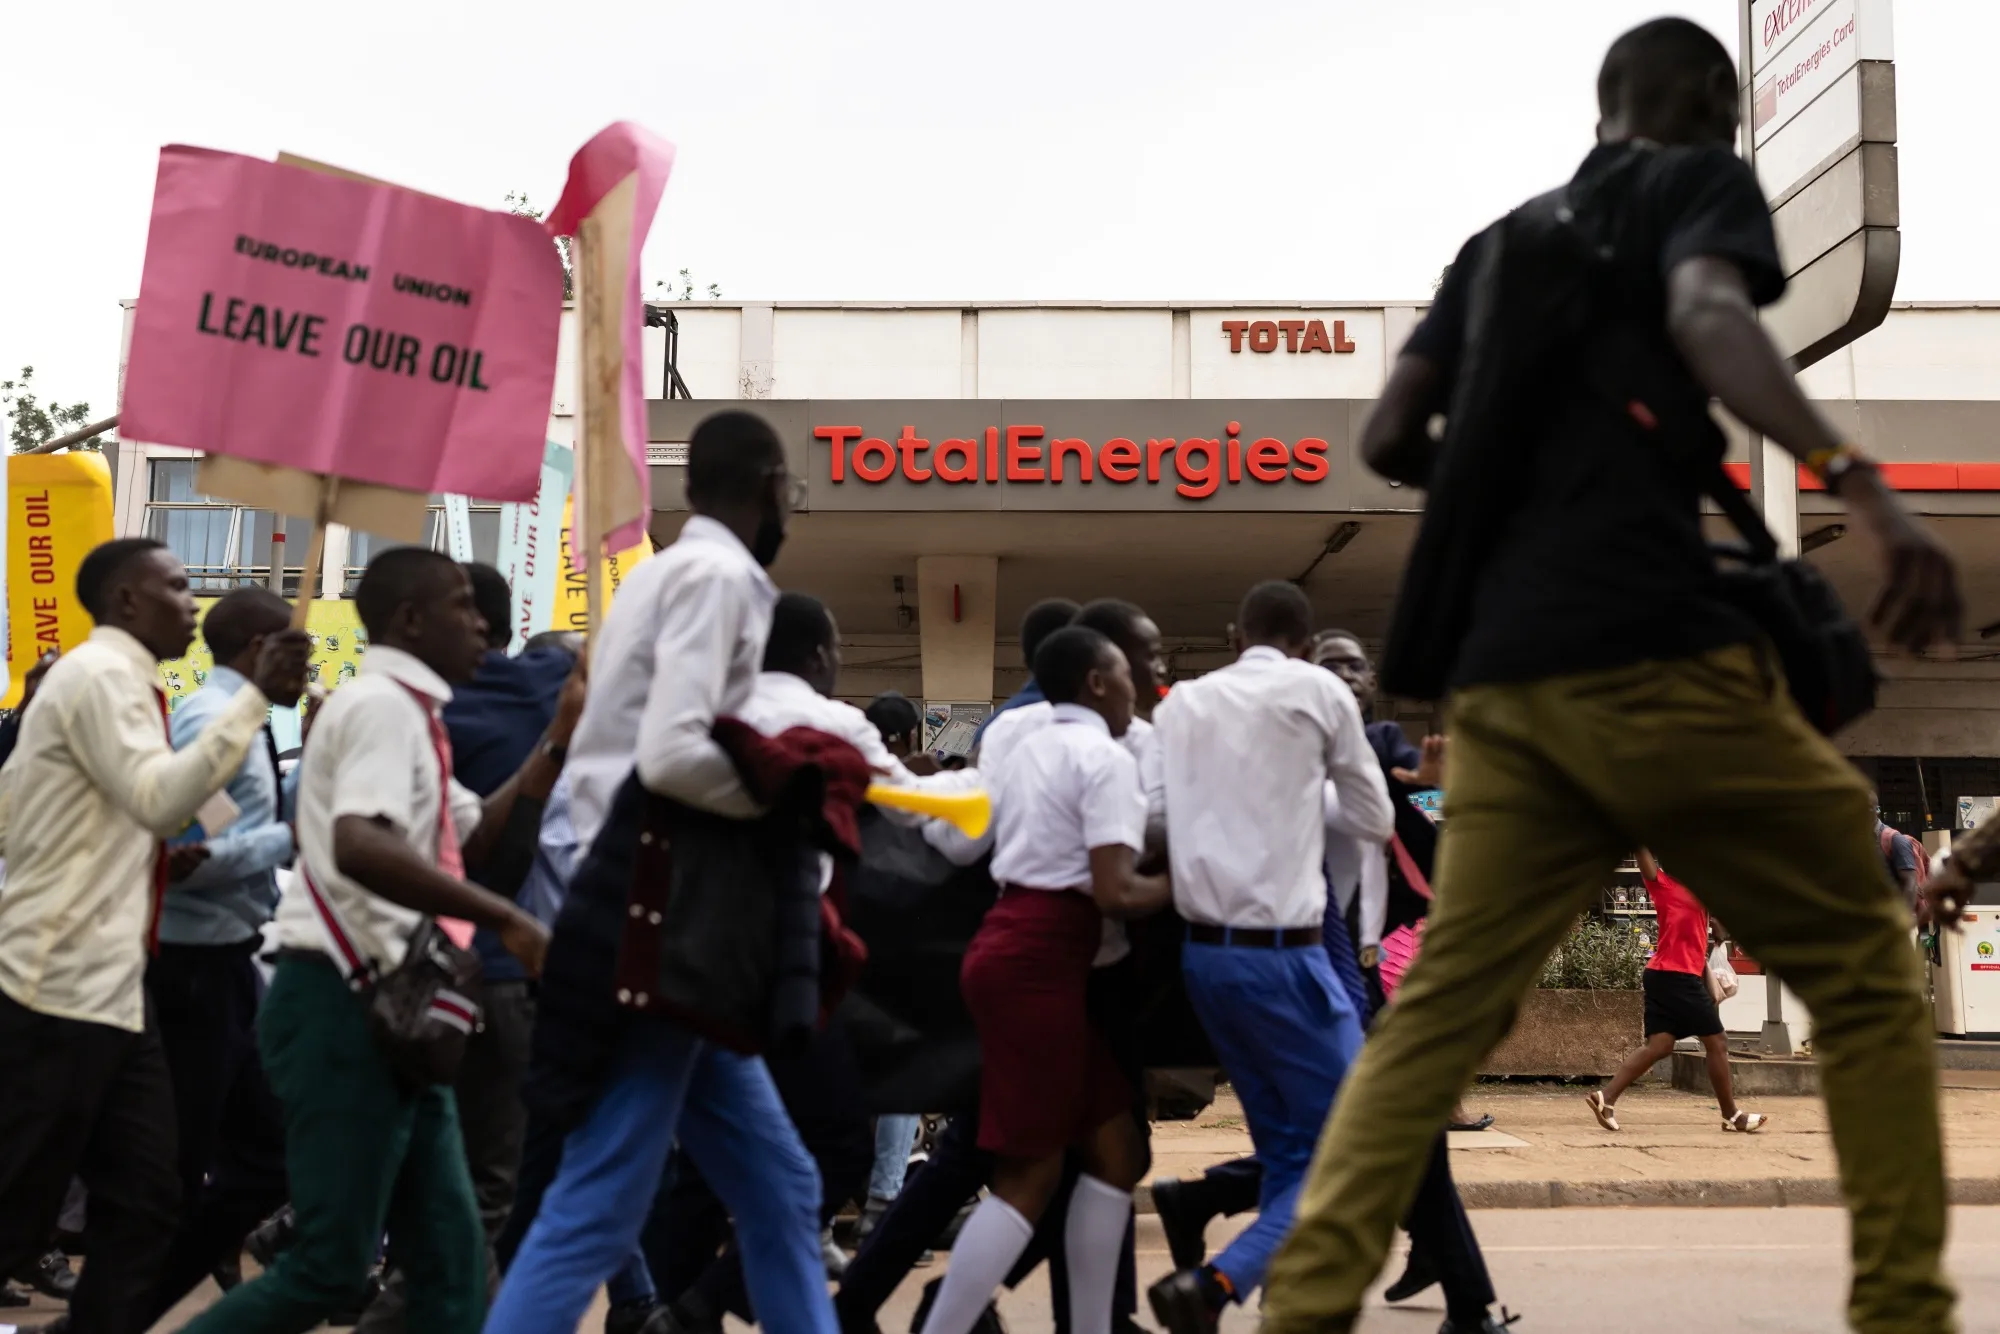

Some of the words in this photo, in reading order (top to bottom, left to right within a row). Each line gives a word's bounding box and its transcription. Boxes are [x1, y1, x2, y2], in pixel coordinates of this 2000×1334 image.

[1777, 41, 1831, 97] TotalEnergies
[1833, 13, 1855, 48] Card
[234, 234, 370, 282] EUROPEAN
[393, 273, 472, 307] UNION
[197, 292, 327, 358] LEAVE
[344, 324, 421, 377] OUR
[430, 343, 490, 392] OIL
[1222, 320, 1356, 353] TOTAL
[814, 421, 1330, 498] TotalEnergies
[25, 489, 51, 530] OIL
[29, 535, 55, 585] OUR
[524, 524, 538, 578] OUR
